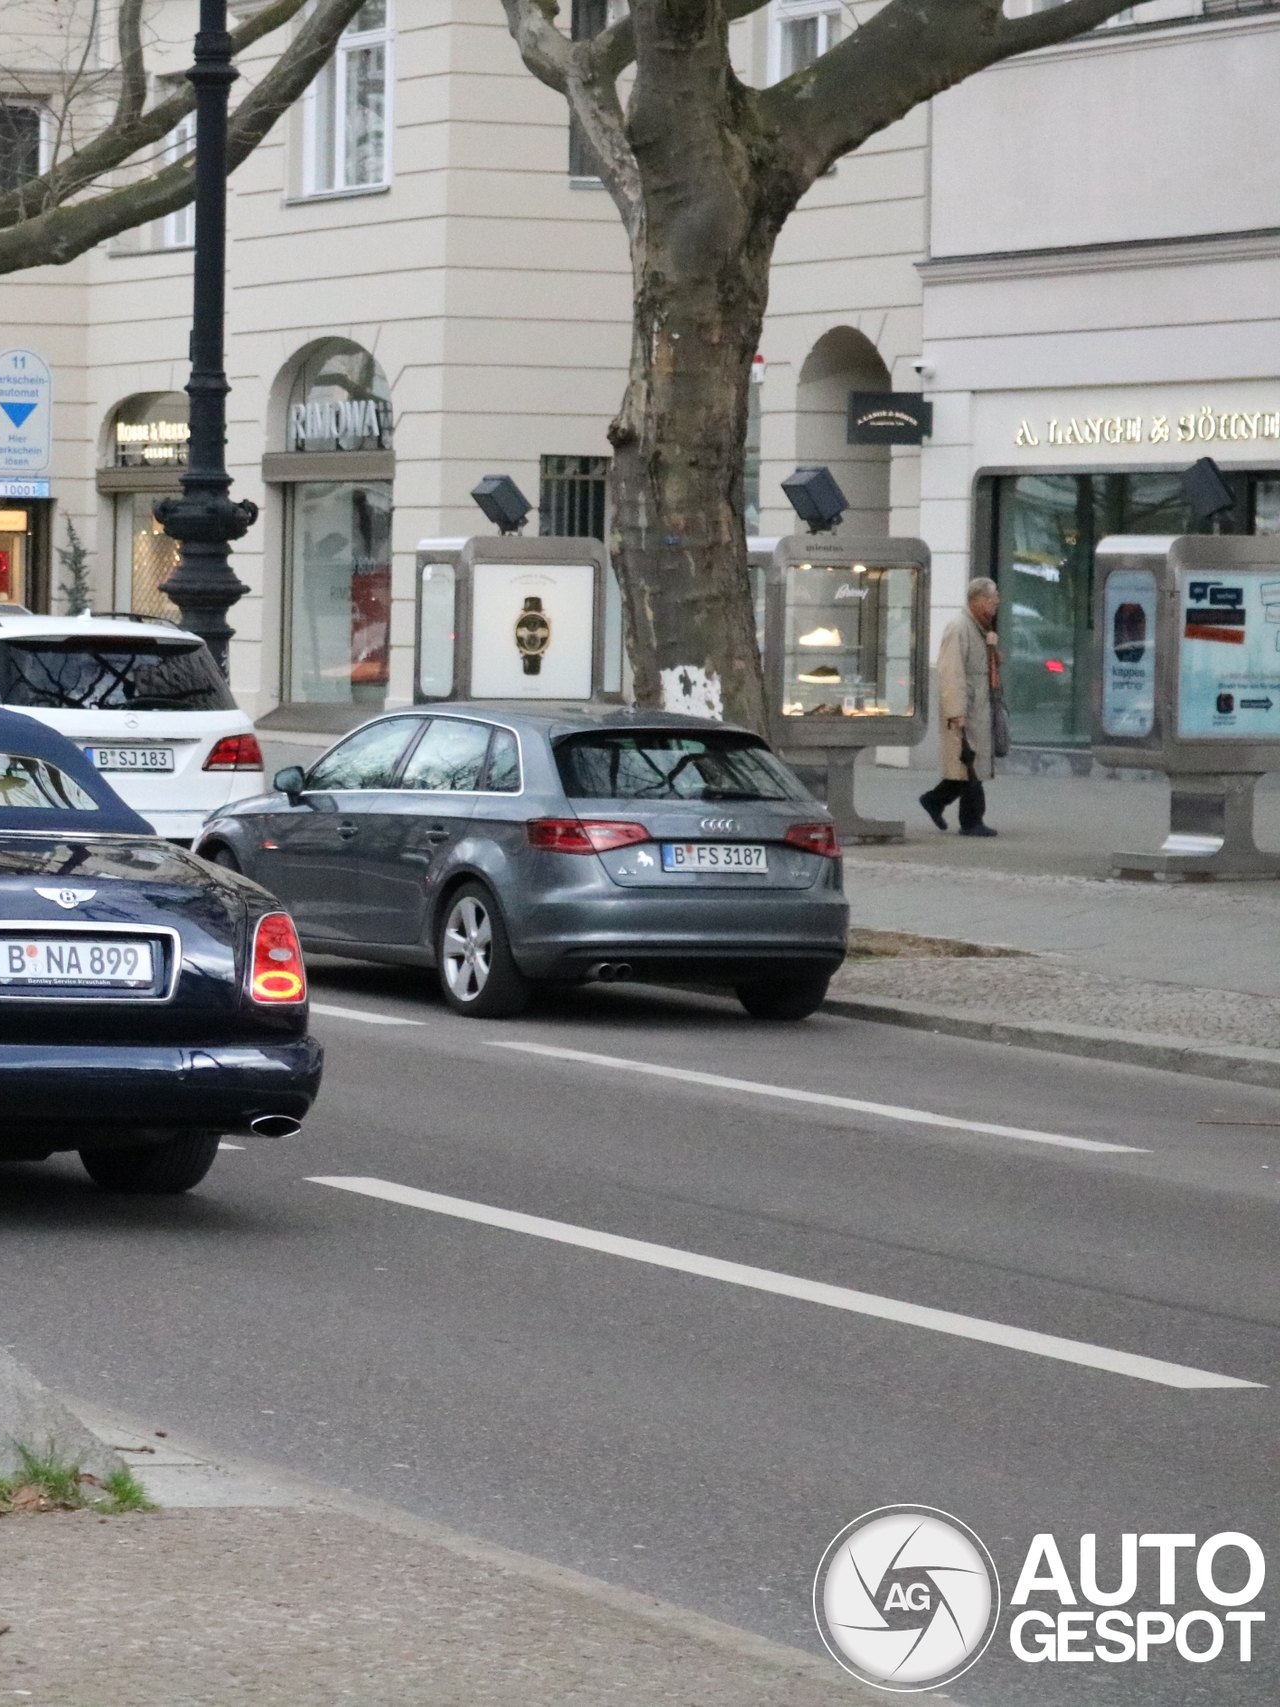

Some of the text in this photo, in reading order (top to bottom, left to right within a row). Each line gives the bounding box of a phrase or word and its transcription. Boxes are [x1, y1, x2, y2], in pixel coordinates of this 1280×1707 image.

[11, 355, 26, 369] 11
[291, 399, 380, 439] RIMOWA
[1047, 416, 1142, 445] LANGE
[1149, 415, 1170, 444] &
[1176, 405, 1280, 442] SÖHNE
[8, 434, 27, 443] Hier
[4, 457, 29, 466] lösen
[4, 485, 36, 495] 10001
[99, 751, 167, 766] B SJ 183
[674, 847, 762, 866] B FS 3187
[8, 945, 139, 976] B NA 899
